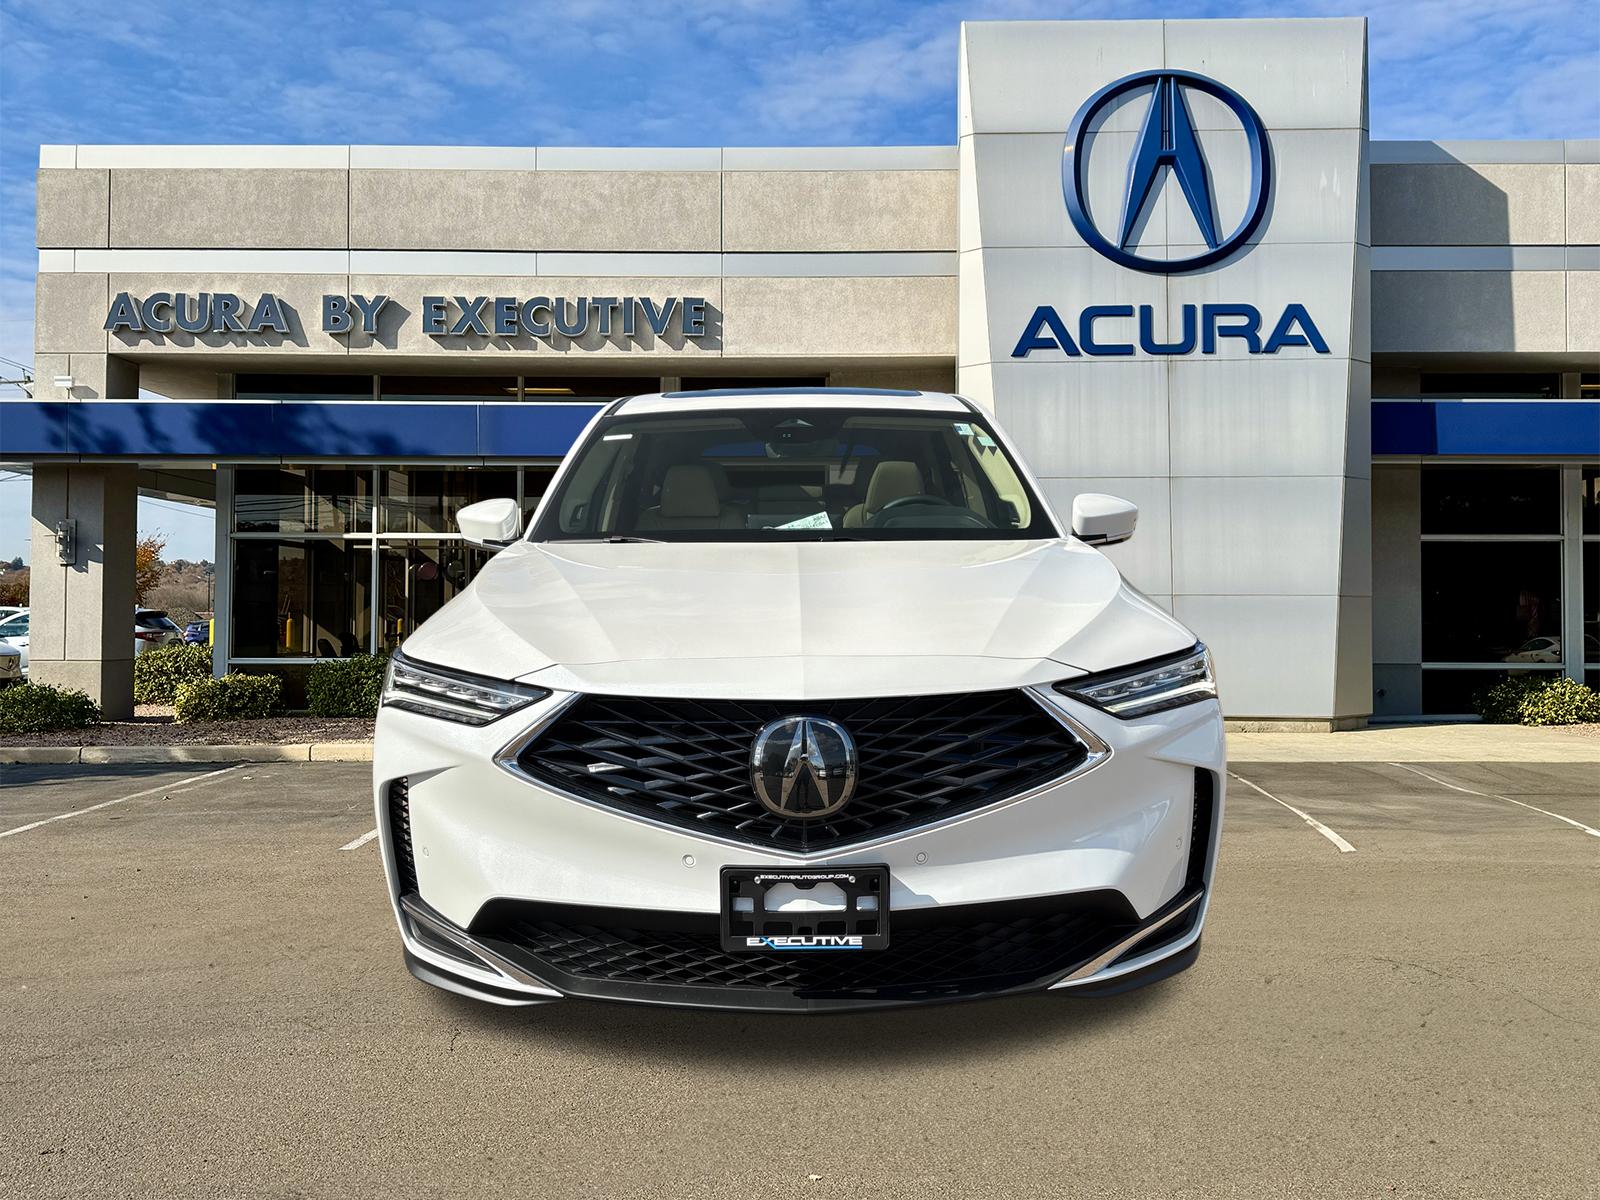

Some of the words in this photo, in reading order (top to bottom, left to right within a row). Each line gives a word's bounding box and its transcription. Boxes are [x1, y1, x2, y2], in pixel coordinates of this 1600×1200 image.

[103, 292, 289, 333] ACURA
[322, 294, 391, 334] BY
[422, 296, 705, 336] EXECUTIVE
[1010, 303, 1332, 357] ACURA
[746, 936, 863, 947] EXECUTIVE
